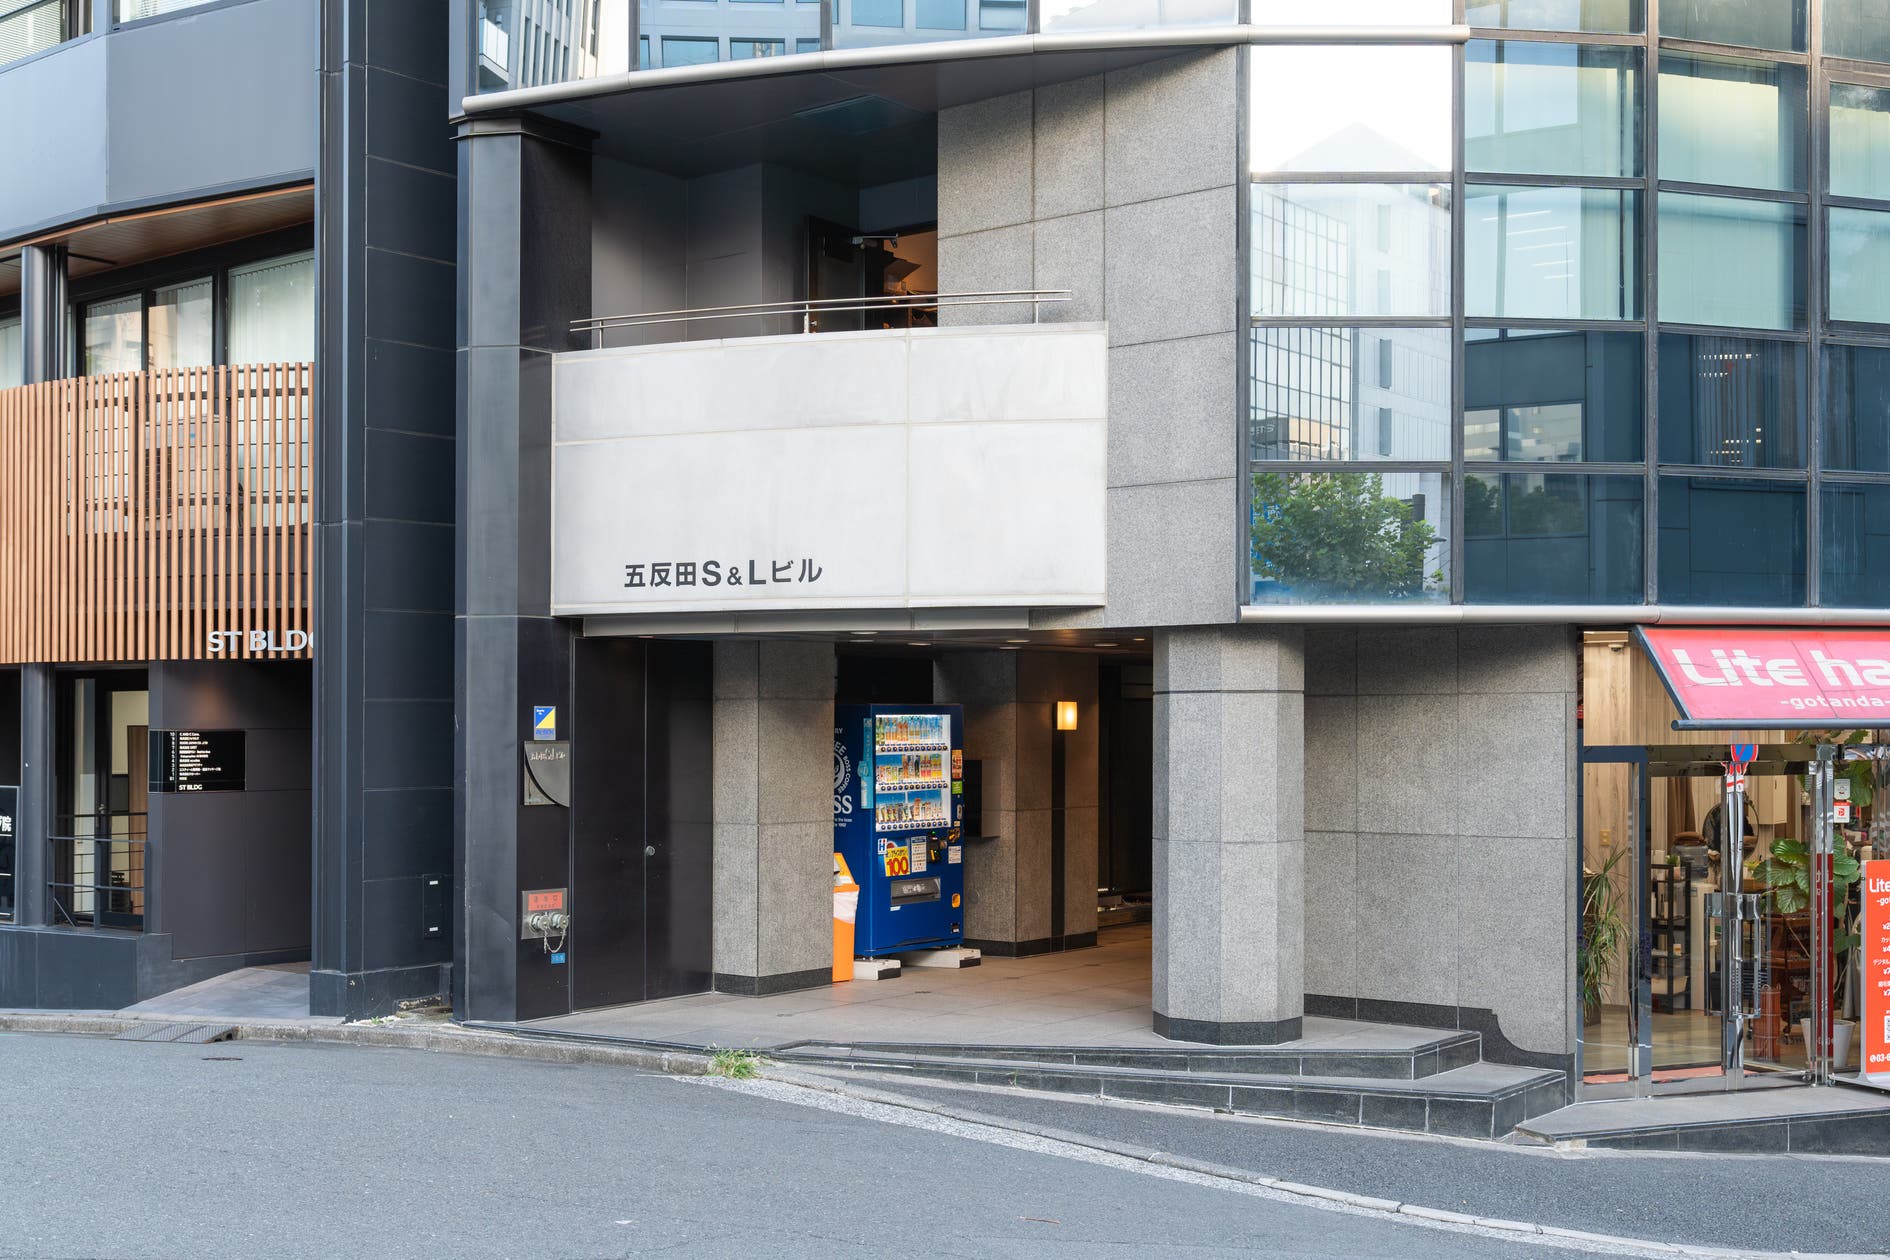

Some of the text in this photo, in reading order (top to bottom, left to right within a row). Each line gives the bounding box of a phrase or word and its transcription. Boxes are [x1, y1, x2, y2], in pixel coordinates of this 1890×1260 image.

[624, 558, 823, 588] 五反田S&Lビル
[207, 631, 243, 652] ST
[1671, 649, 1809, 687] Lite
[1780, 695, 1890, 710] -gotanda-
[0, 815, 12, 832] 院
[887, 856, 909, 876] 100
[1869, 878, 1890, 893] Lite
